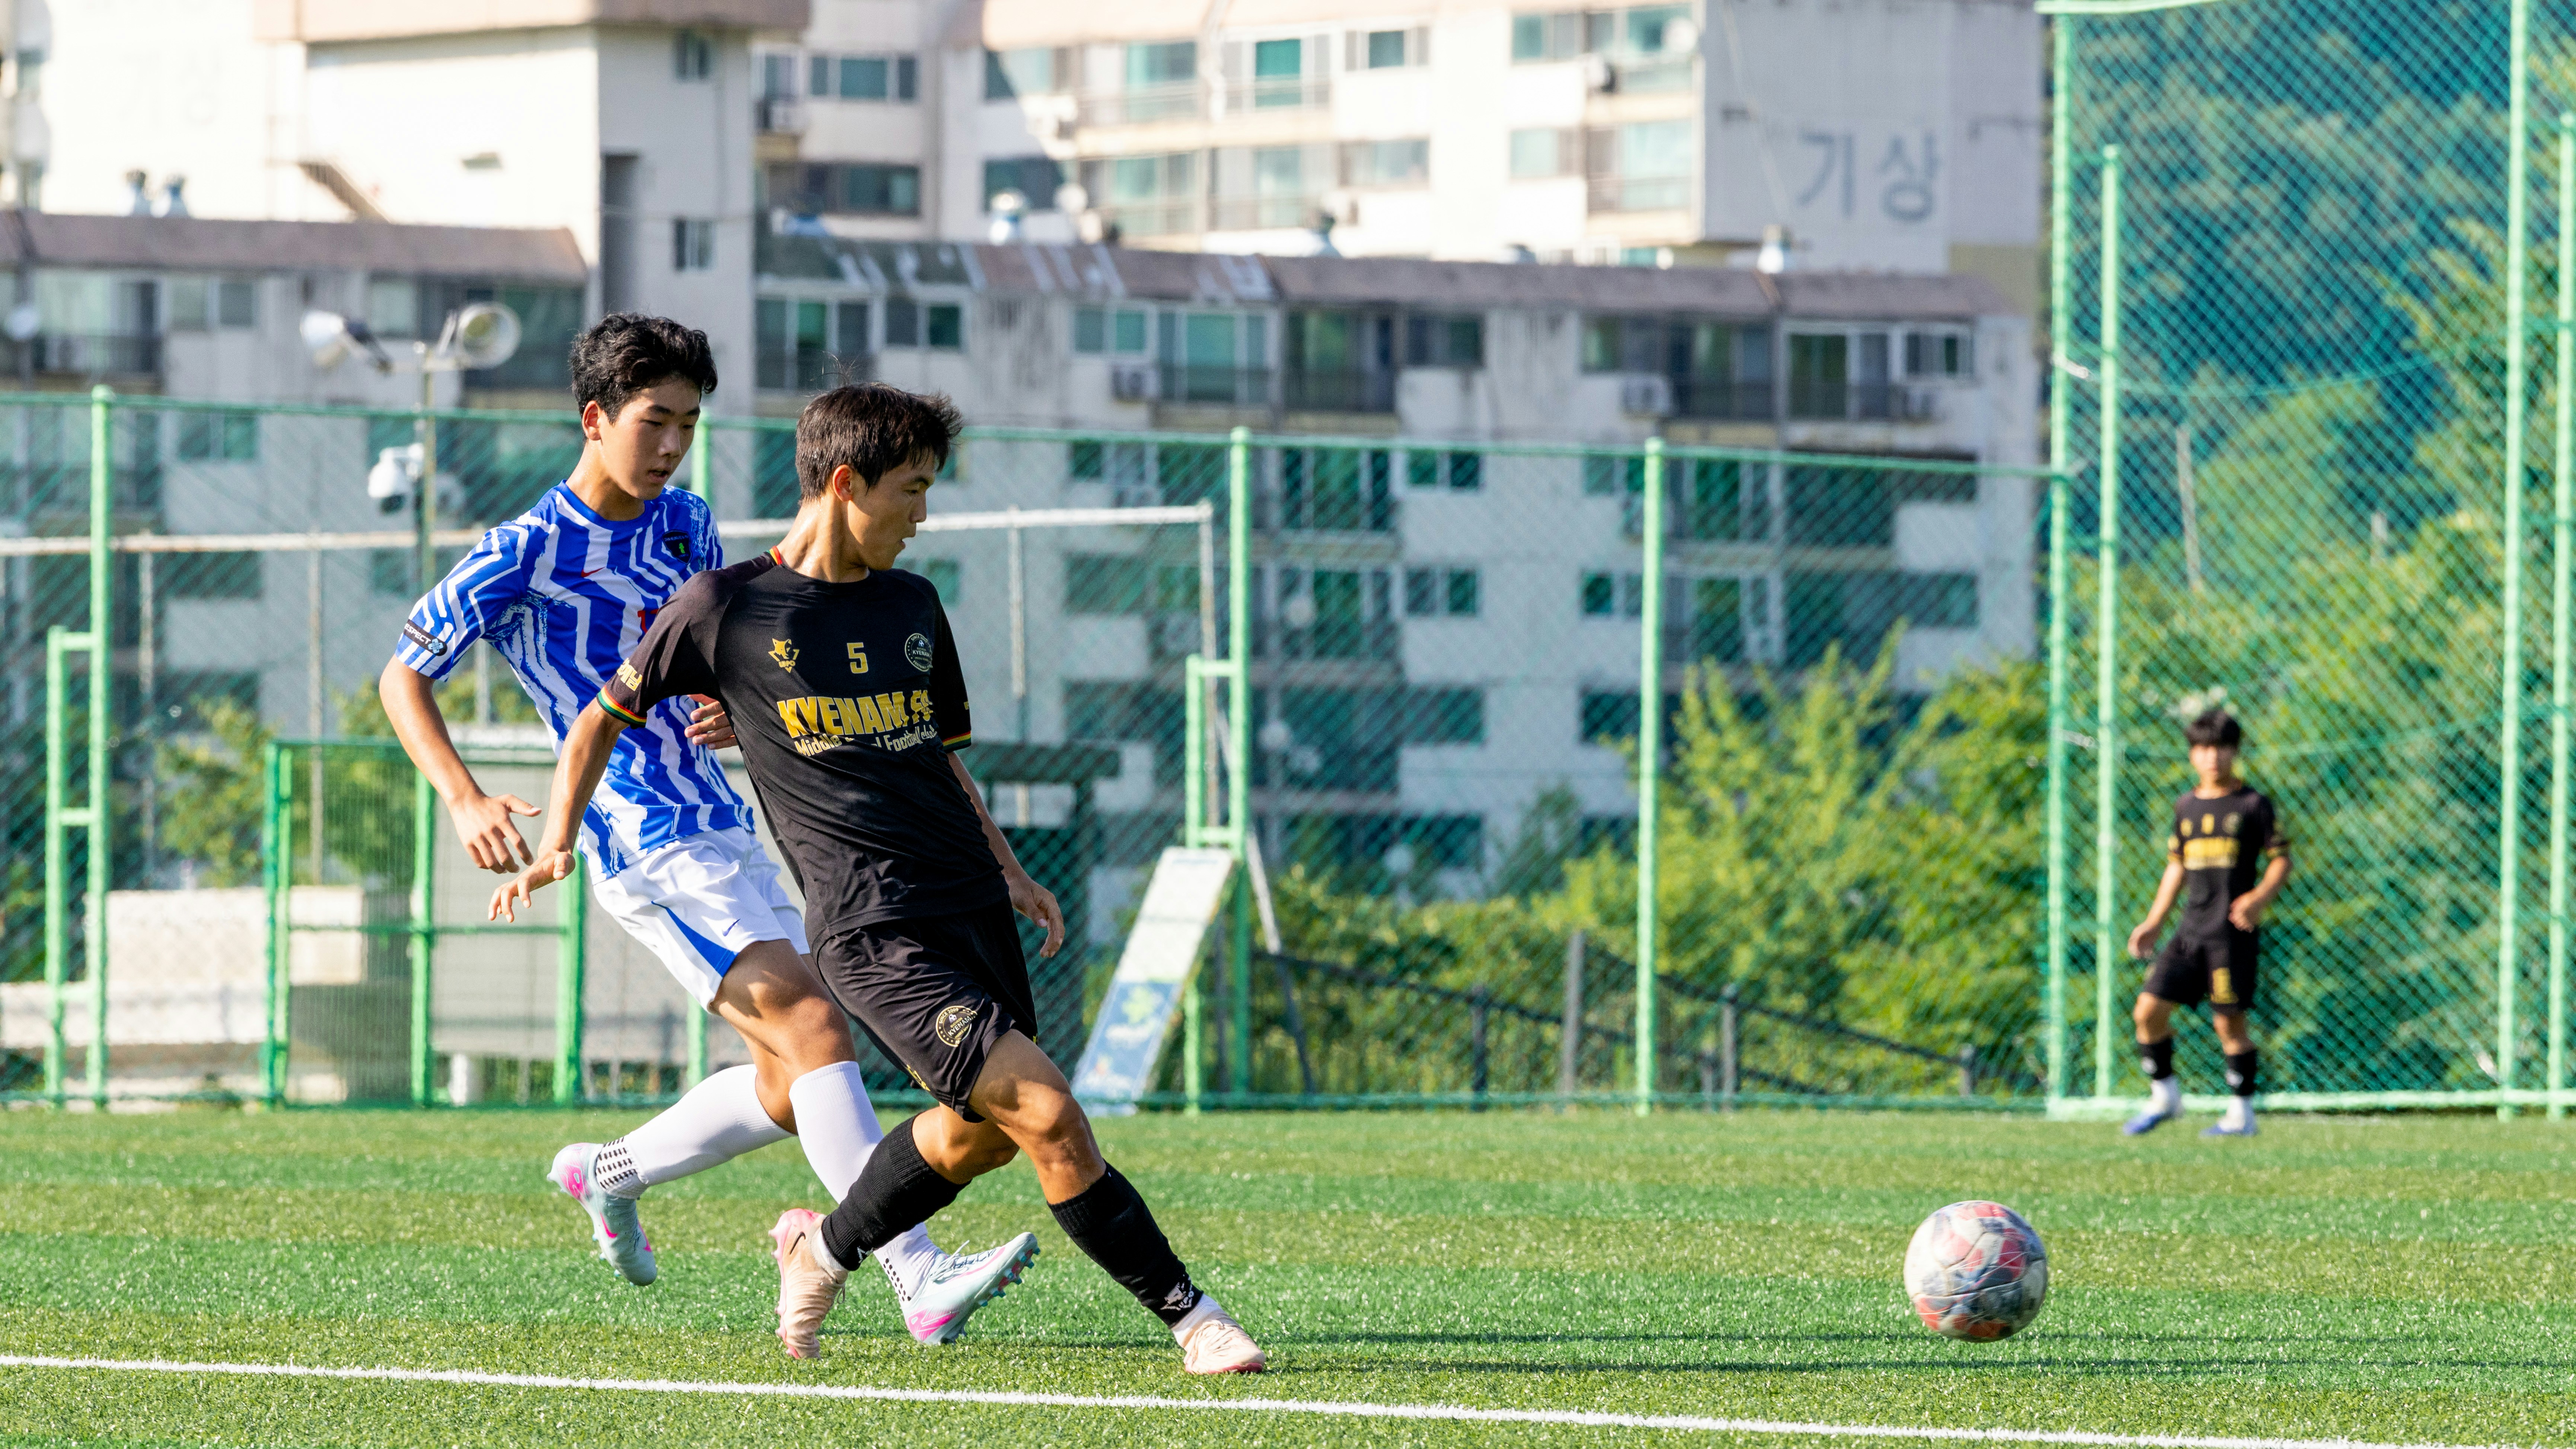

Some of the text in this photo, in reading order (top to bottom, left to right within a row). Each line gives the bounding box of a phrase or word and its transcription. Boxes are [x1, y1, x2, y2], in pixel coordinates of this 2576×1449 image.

[1796, 130, 1942, 223] 기상
[404, 623, 431, 644] ESPECT
[847, 642, 868, 674] 5
[777, 691, 909, 739] KYENAM
[794, 733, 842, 757] Middle
[938, 1011, 949, 1024] SINCE
[947, 1015, 972, 1036] KYENAM
